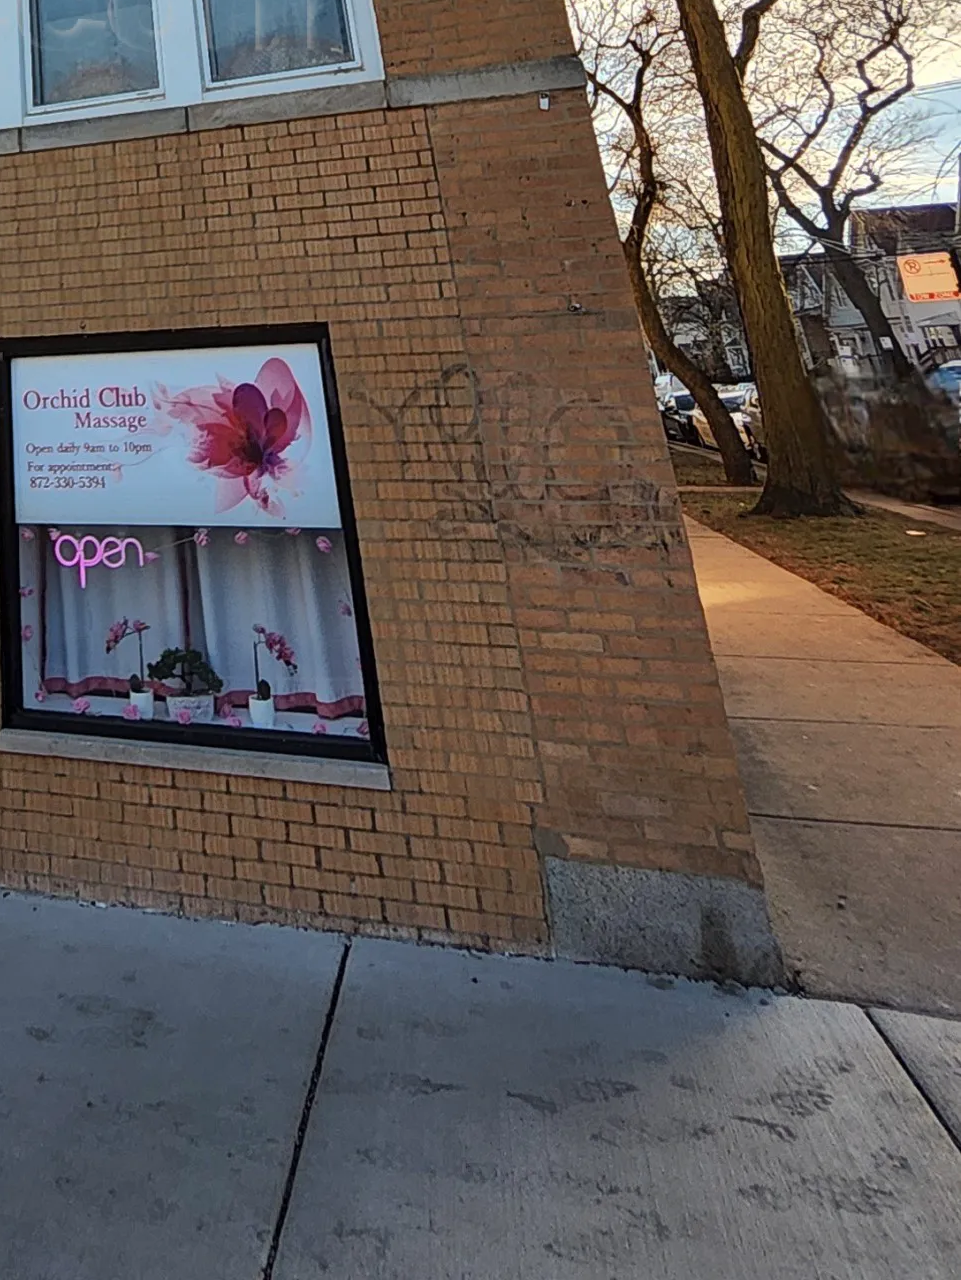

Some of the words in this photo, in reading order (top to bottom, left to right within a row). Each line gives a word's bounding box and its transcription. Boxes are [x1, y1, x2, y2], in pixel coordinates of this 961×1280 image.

[23, 388, 90, 410] Orchid
[98, 386, 146, 408] Club
[74, 411, 147, 433] Massage
[25, 443, 54, 456] Open
[56, 442, 80, 456] daily
[83, 442, 105, 453] 9am
[109, 443, 119, 453] to
[123, 441, 152, 455] 10pm
[27, 461, 44, 472] For
[54, 534, 144, 589] open
